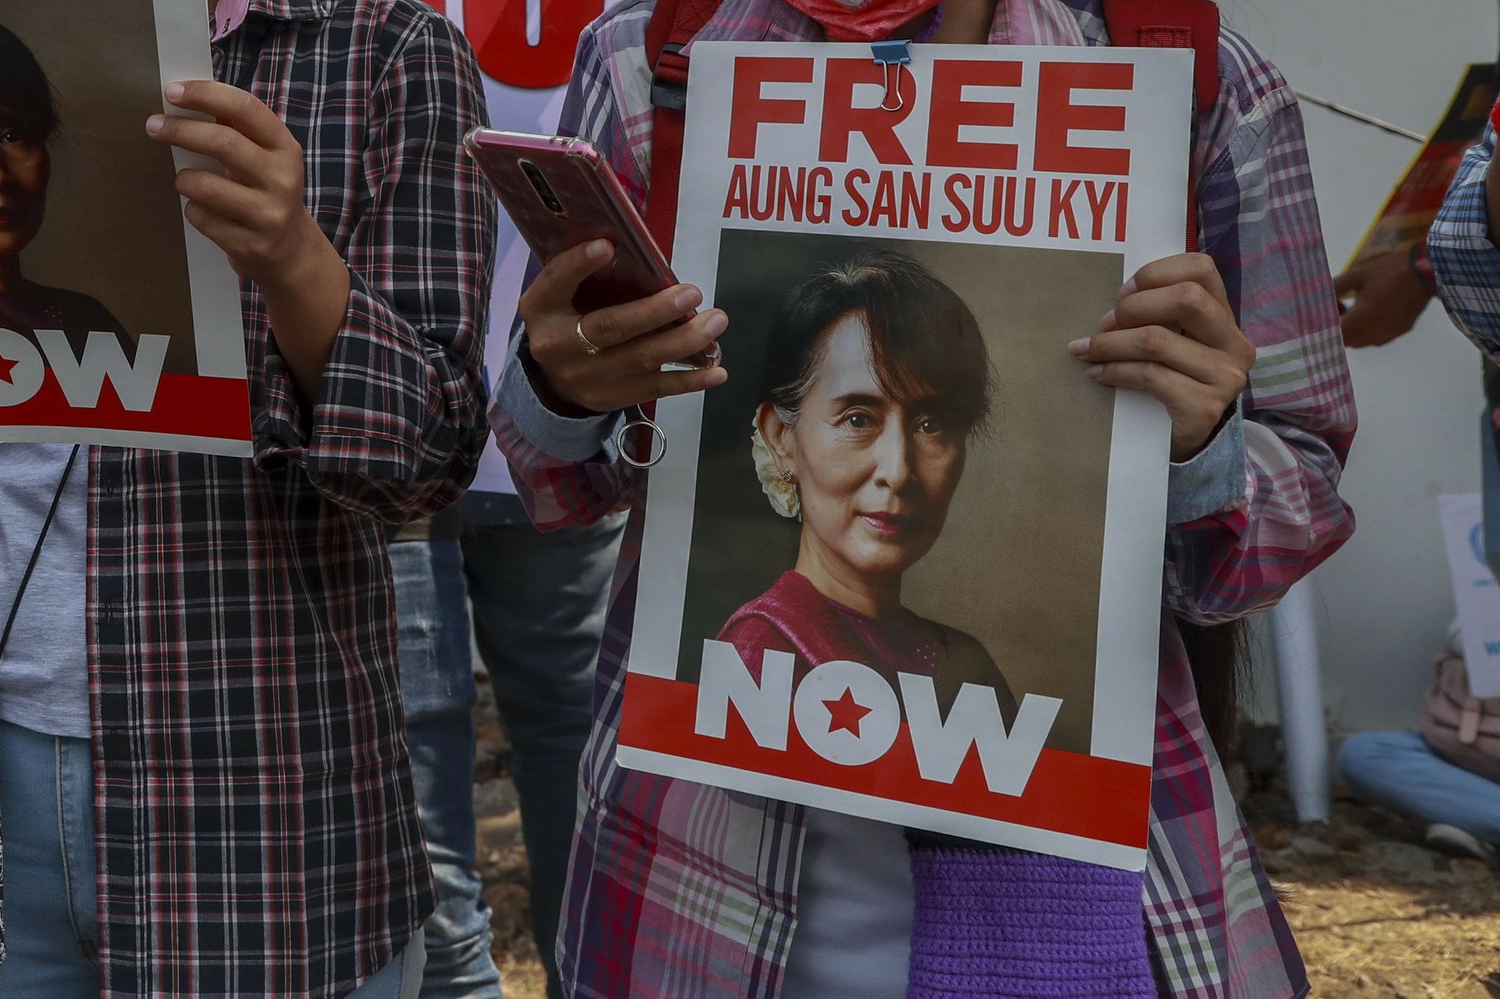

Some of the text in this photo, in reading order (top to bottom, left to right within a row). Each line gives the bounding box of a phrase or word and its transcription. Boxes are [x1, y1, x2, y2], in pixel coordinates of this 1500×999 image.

[728, 56, 1135, 176] FREE
[723, 164, 1129, 243] AUNG SAN SUU KYI
[694, 638, 1065, 799] NOW
